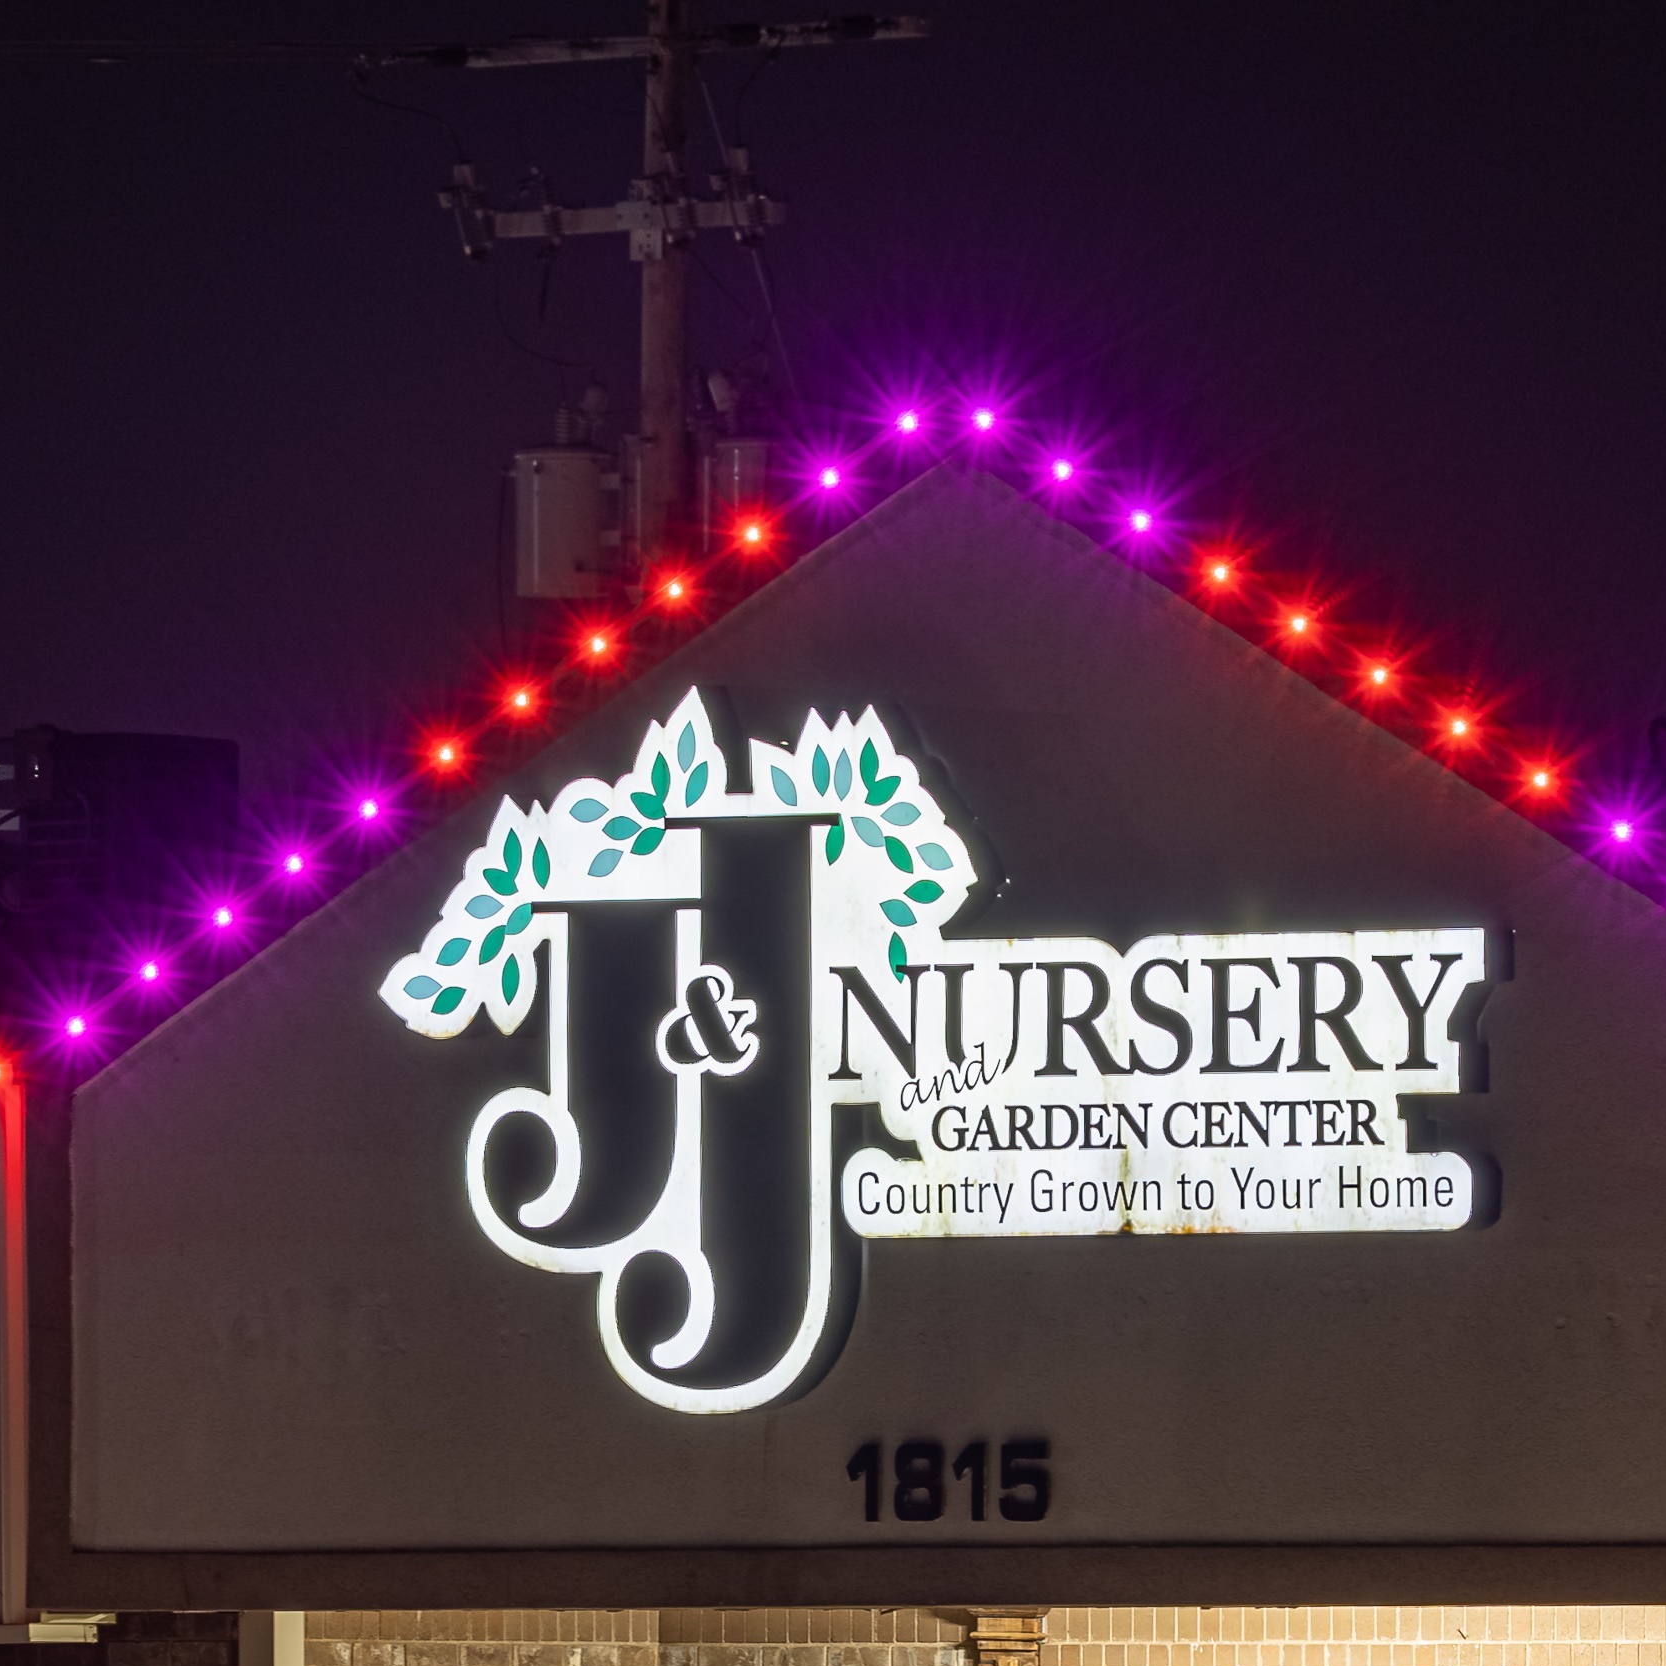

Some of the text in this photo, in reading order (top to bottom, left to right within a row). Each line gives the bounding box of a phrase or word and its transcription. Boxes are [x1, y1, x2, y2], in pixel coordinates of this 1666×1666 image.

[828, 954, 1463, 1081] NURSERY
[484, 814, 841, 1389] J & J
[900, 1041, 1001, 1111] and
[931, 1099, 1385, 1151] GARDEN CENTER
[857, 1165, 1454, 1224] Country Grown to Your Home
[846, 1438, 1053, 1523] 1815
